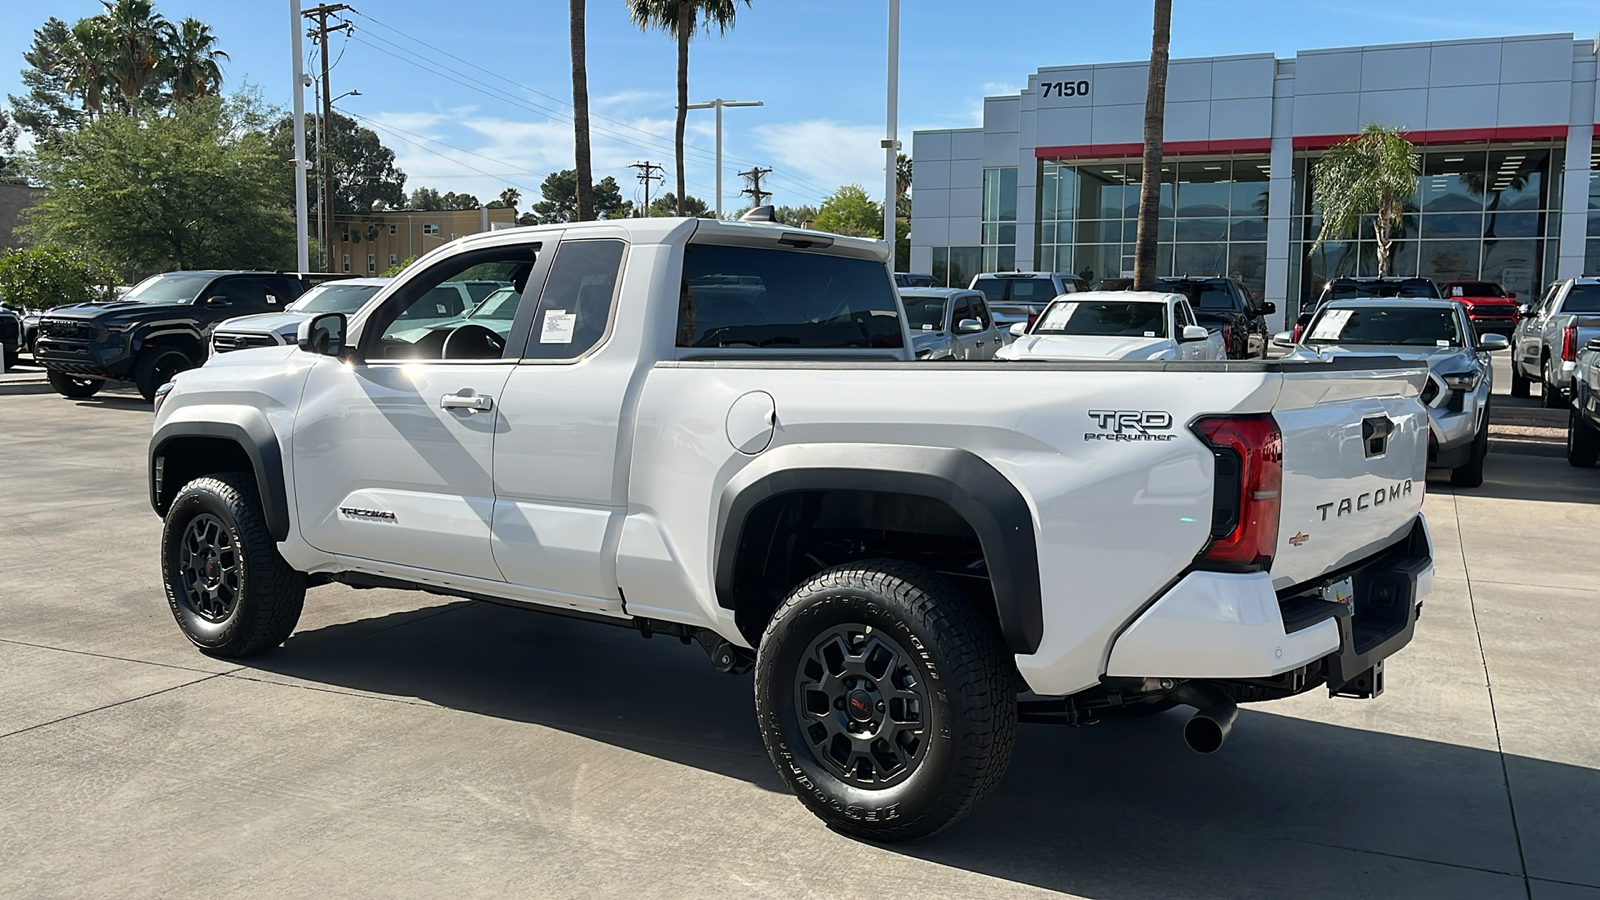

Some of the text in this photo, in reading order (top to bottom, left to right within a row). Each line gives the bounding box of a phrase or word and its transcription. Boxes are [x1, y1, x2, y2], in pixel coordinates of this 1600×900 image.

[1041, 80, 1089, 98] 7150
[1088, 410, 1173, 434] TRD
[1316, 479, 1411, 521] TACOMA
[339, 507, 395, 519] TACOMA
